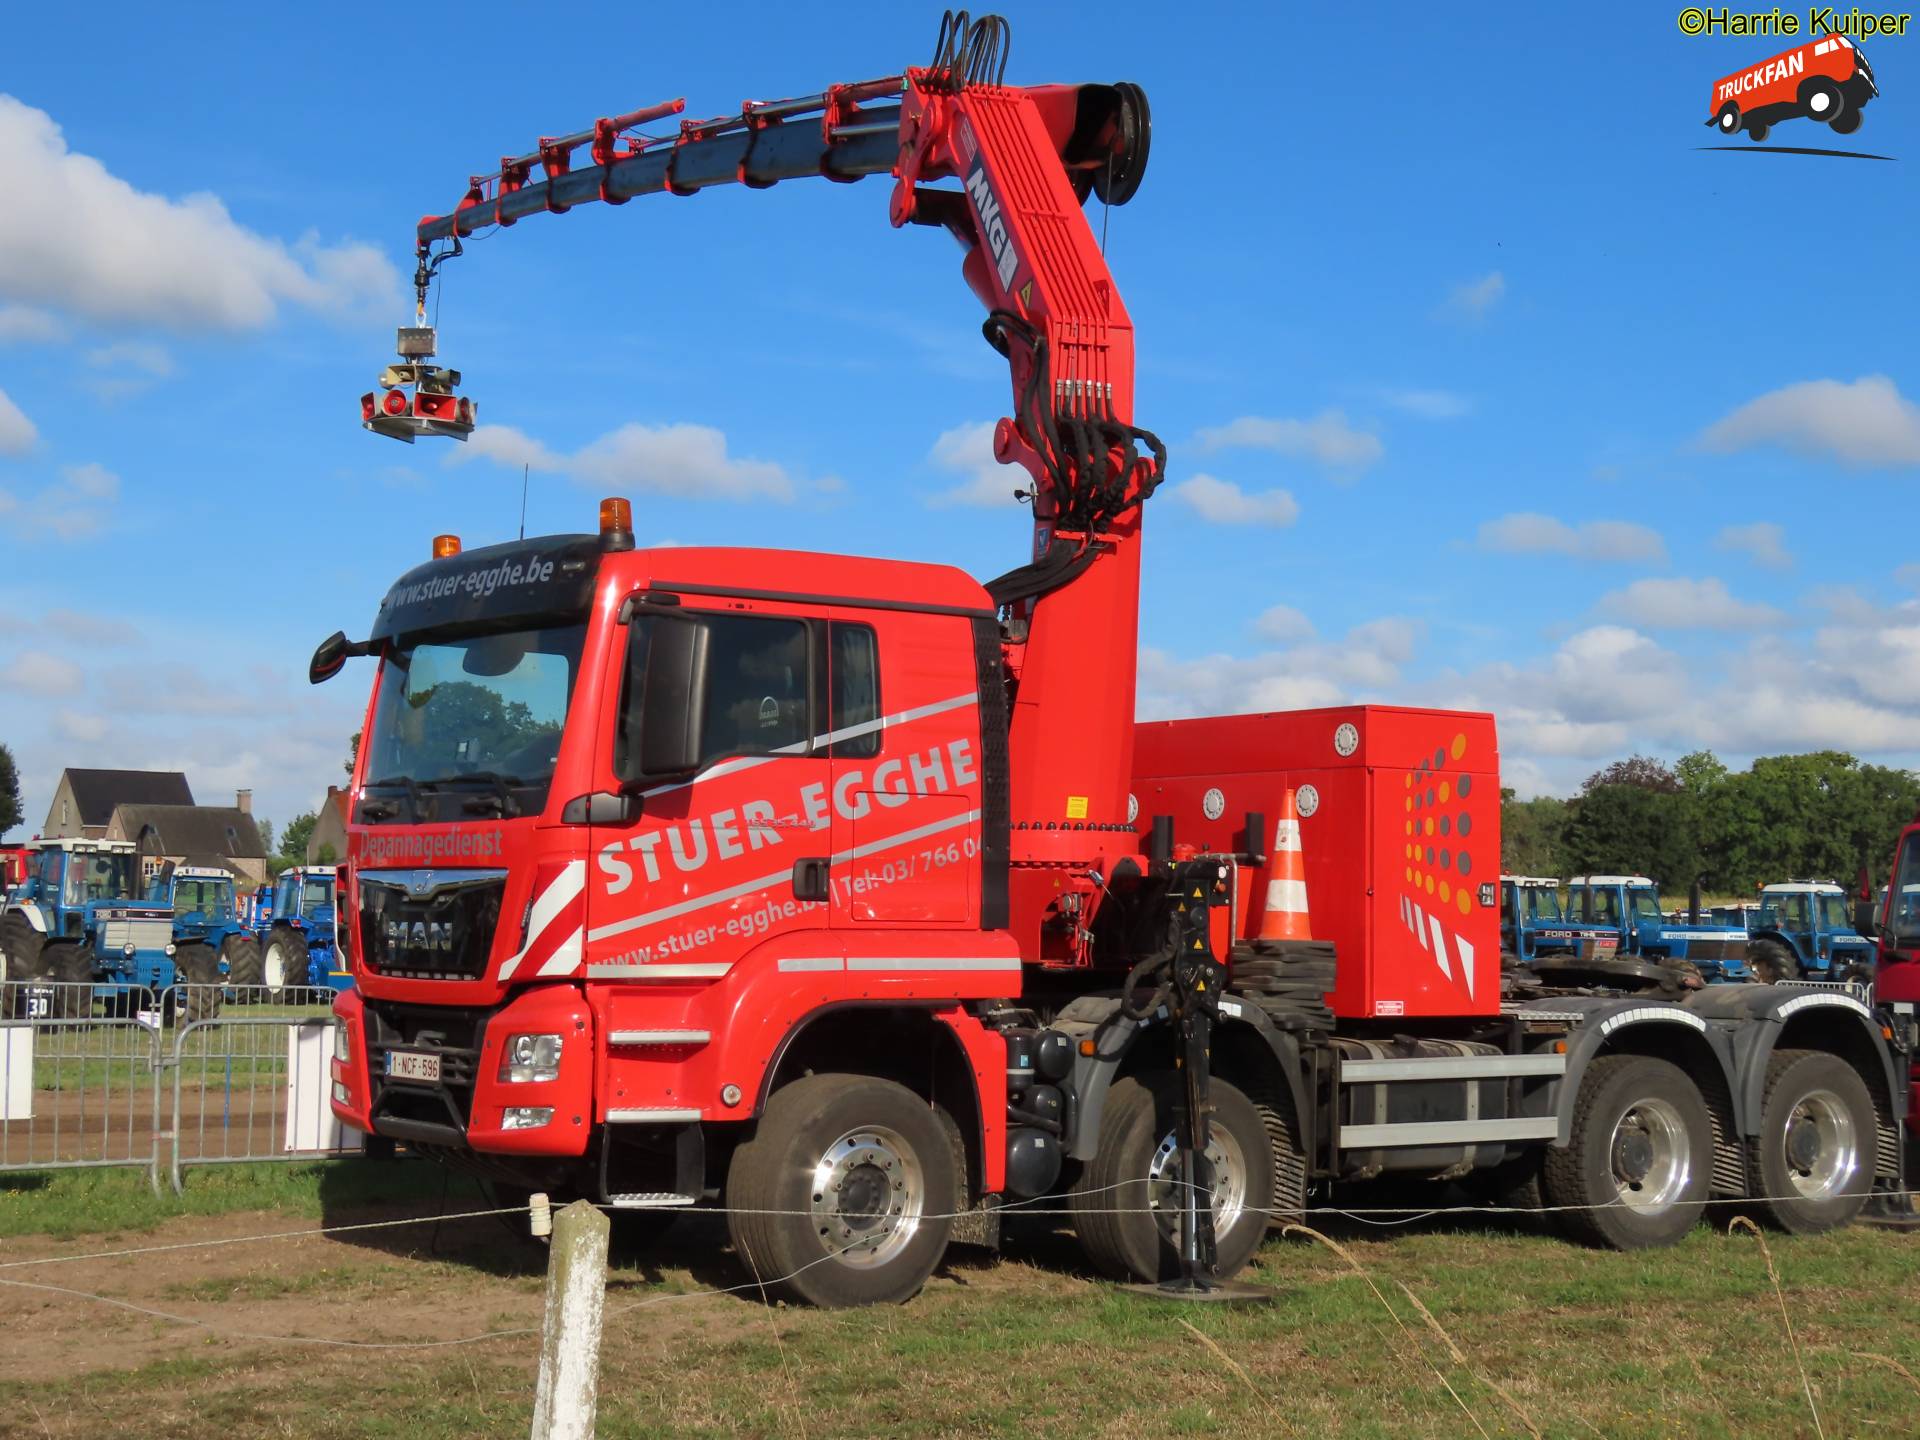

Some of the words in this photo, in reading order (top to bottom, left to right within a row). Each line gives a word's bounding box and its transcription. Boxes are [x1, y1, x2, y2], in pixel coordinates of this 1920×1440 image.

[386, 555, 554, 608] www.stuer-egghe.be
[598, 738, 978, 896] STUER-EGGHE
[360, 828, 502, 865] Depannagedienst
[840, 868, 879, 897] Tel:
[920, 843, 960, 872] 766
[388, 921, 453, 951] MAN
[1544, 930, 1572, 938] FORD
[29, 998, 48, 1016] 30
[392, 1055, 438, 1078] 1-NCF-596
